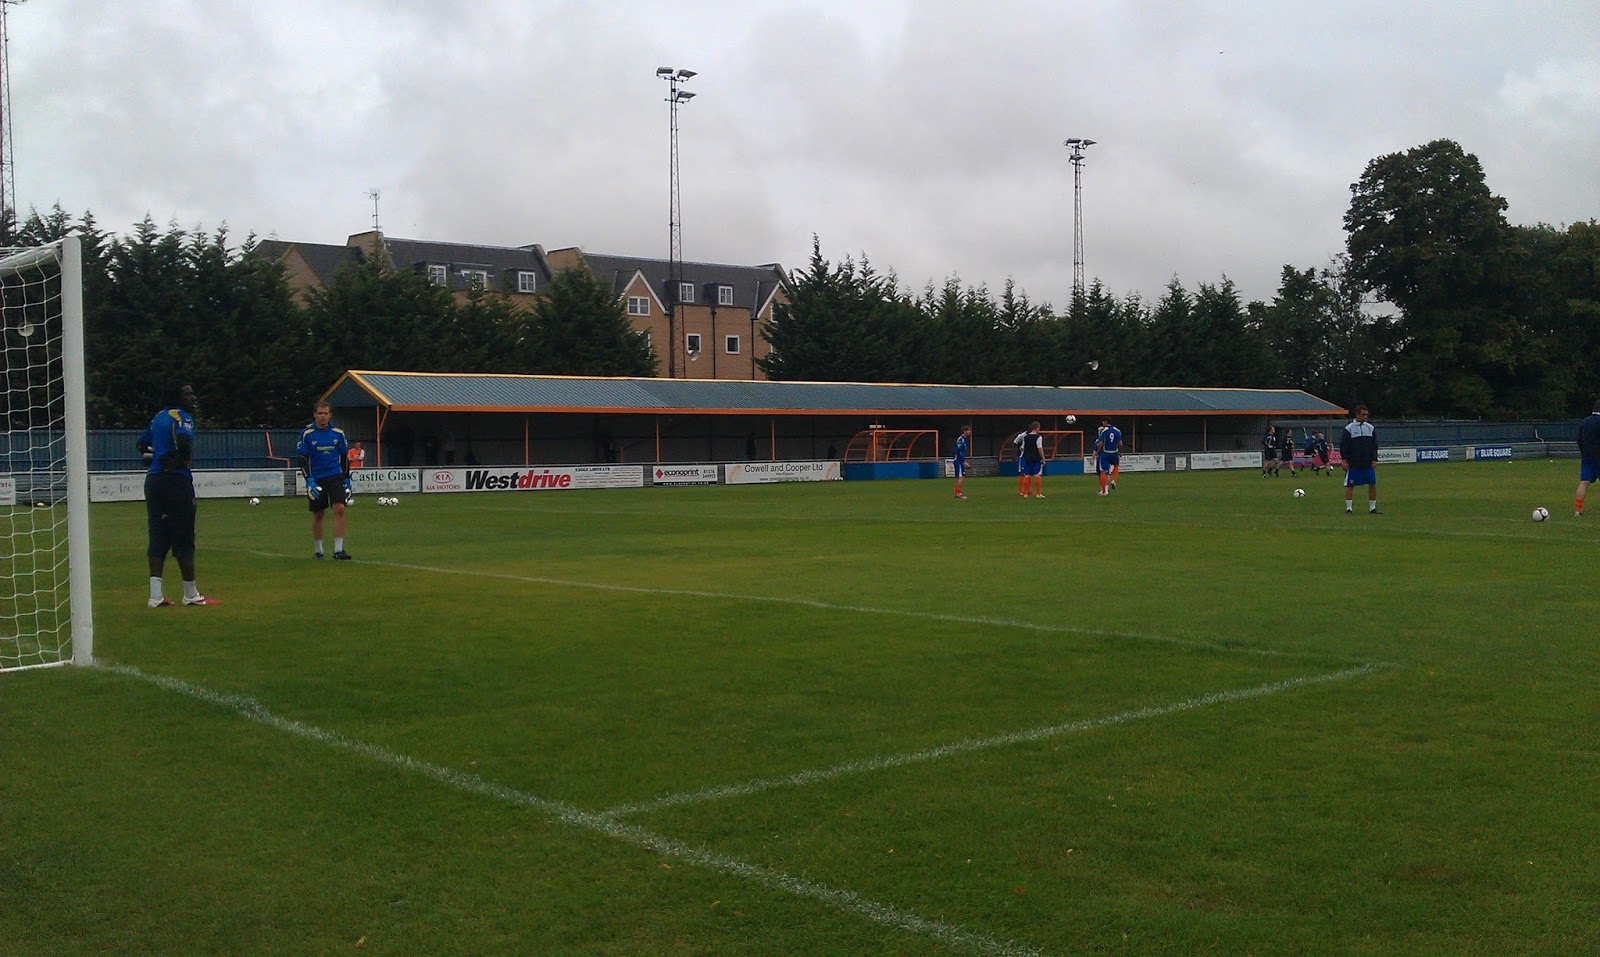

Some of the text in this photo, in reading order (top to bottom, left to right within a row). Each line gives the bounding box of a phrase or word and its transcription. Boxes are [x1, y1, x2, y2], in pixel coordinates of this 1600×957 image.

[1109, 432, 1115, 442] 9
[1421, 450, 1449, 459] BLUE SQUARE
[1480, 448, 1512, 457] BLUE SQUARE
[744, 464, 769, 472] Cowell
[770, 464, 783, 472] and
[785, 463, 811, 473] Cooper
[812, 463, 823, 471] Ltd
[350, 470, 417, 481] Castle Glass
[465, 470, 571, 490] Westdrive
